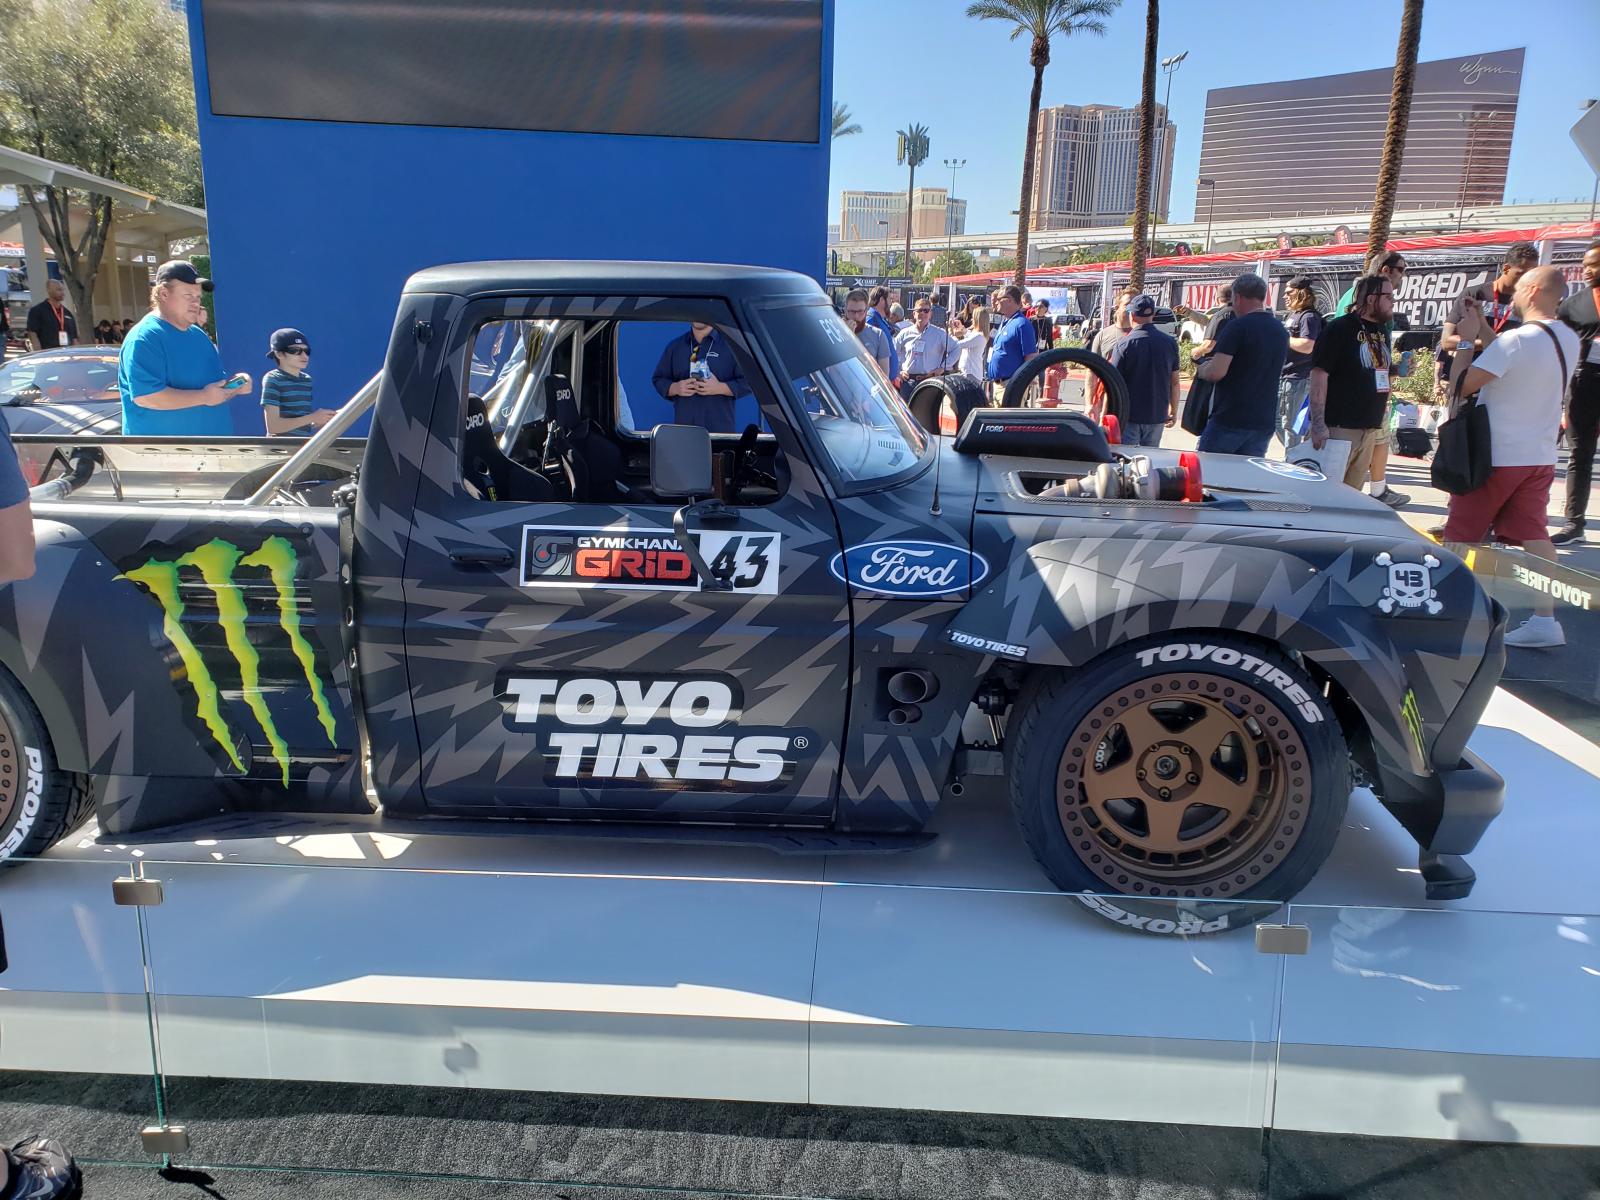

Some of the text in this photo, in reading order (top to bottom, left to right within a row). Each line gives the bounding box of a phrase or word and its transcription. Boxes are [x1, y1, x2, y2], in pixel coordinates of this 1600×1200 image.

[577, 536, 683, 550] GYMKHAN
[709, 536, 774, 588] 43
[861, 546, 958, 587] Ford
[1395, 570, 1424, 588] 43
[950, 632, 1028, 658] TOYO TIRES
[505, 678, 733, 728] TOYO
[1135, 643, 1325, 724] TOYO TIRES
[548, 732, 791, 783] TIRES
[1076, 889, 1229, 935] PROXES
